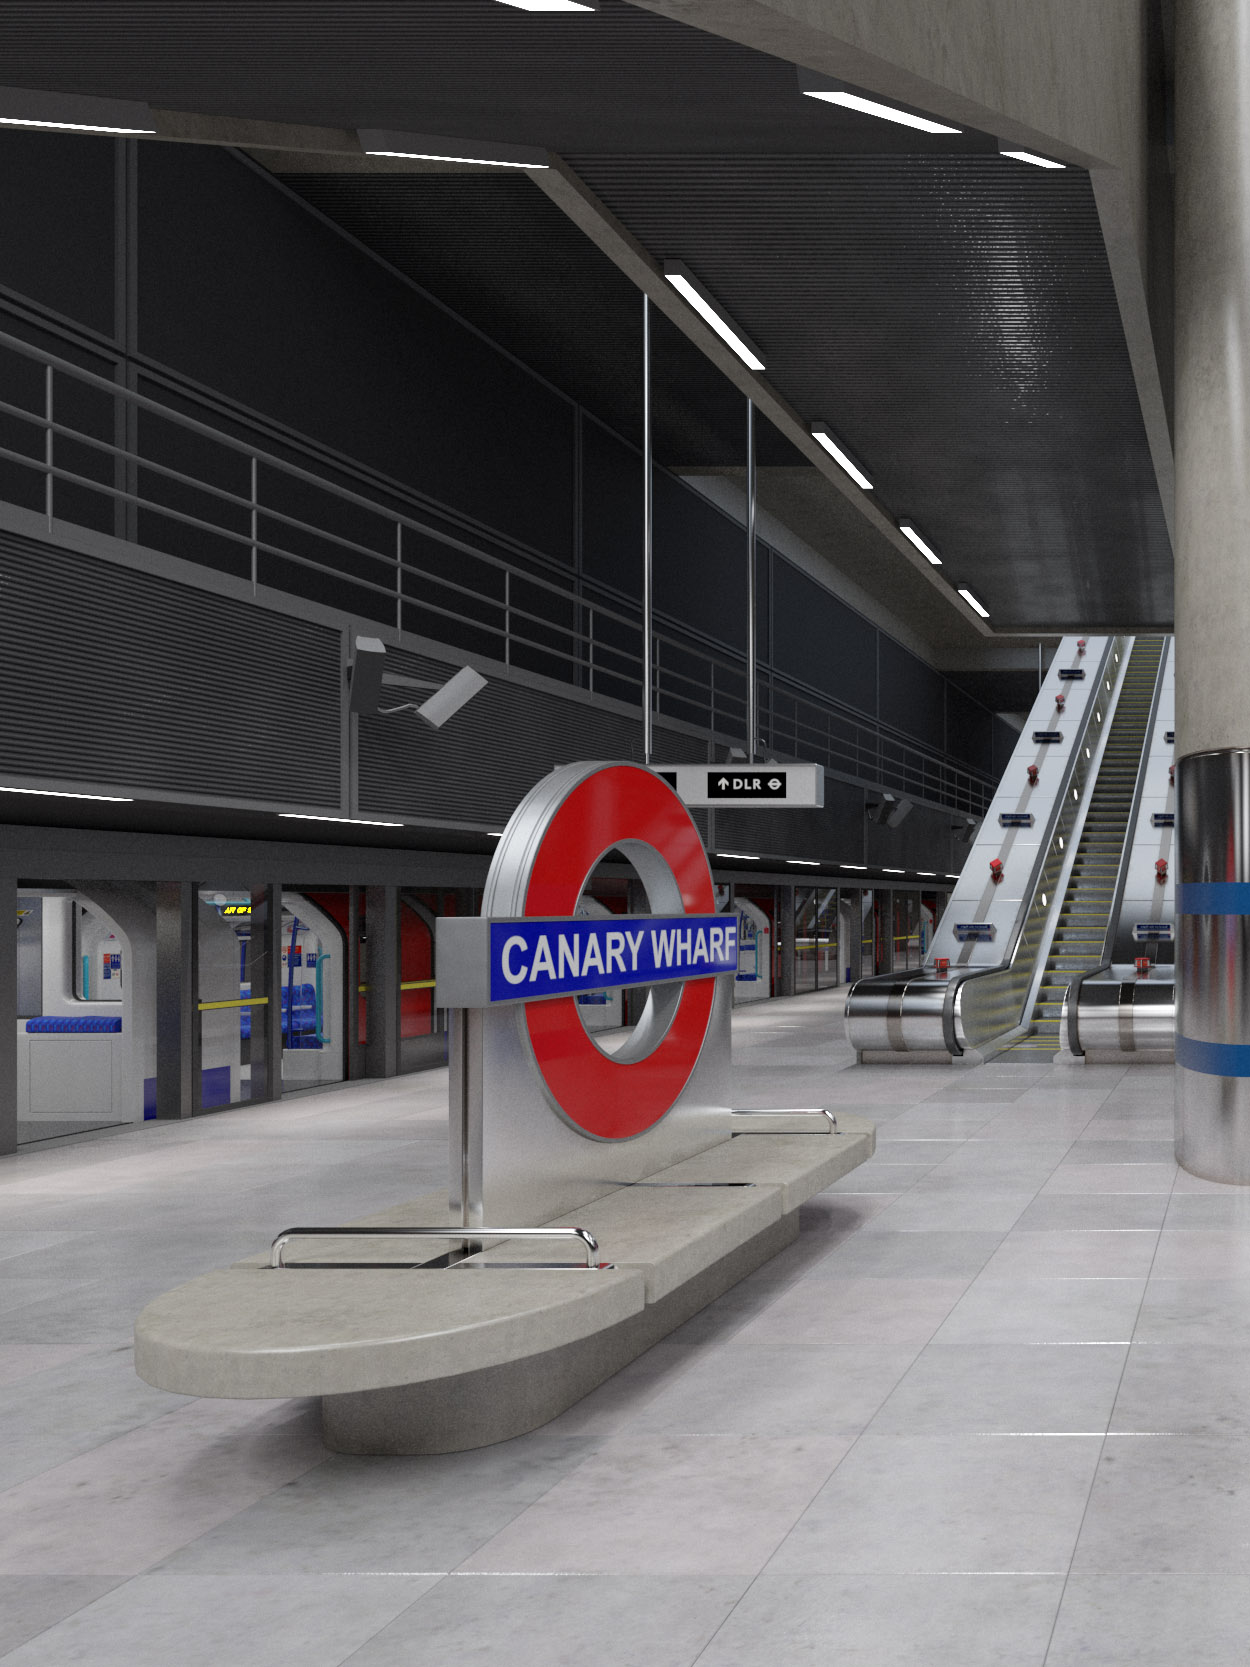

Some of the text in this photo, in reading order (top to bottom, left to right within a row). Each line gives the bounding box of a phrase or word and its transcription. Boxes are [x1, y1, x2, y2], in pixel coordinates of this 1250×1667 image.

[733, 778, 762, 790] DLR
[501, 926, 737, 985] CANARY WHARF
